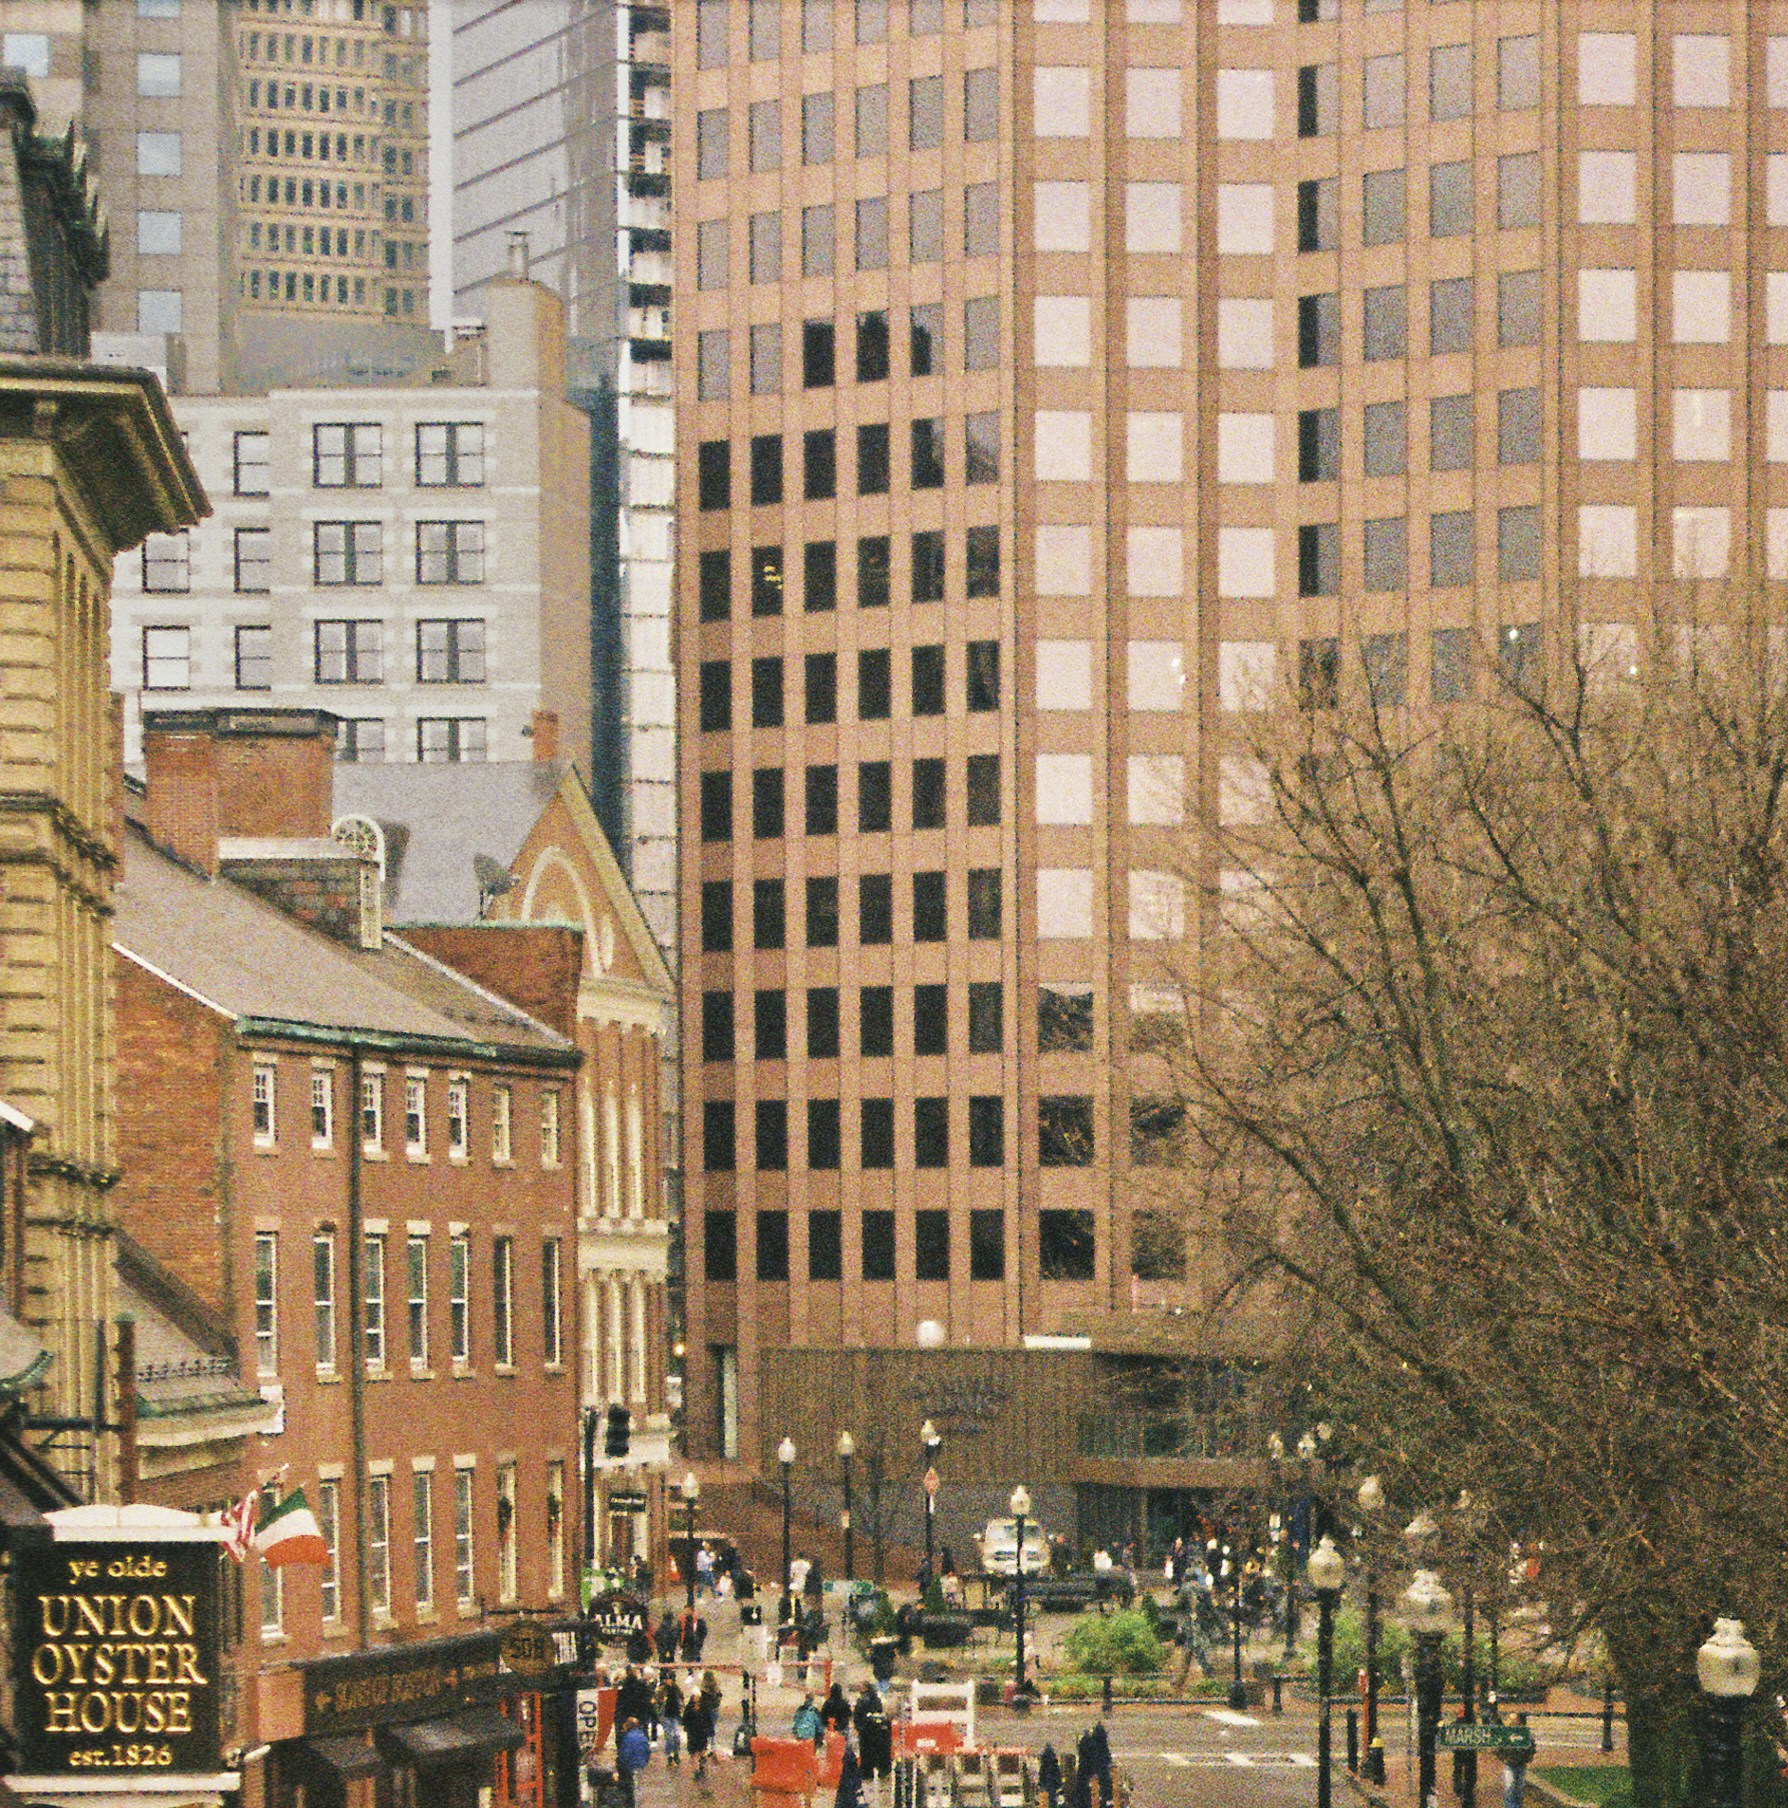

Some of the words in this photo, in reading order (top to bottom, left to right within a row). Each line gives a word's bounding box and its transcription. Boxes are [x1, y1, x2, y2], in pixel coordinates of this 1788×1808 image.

[68, 1559, 99, 1585] ye
[108, 1556, 168, 1578] olde
[38, 1595, 196, 1636] UNION
[32, 1643, 207, 1685] OYSTER
[44, 1692, 192, 1733] HOUSE
[69, 1745, 173, 1766] est.1826
